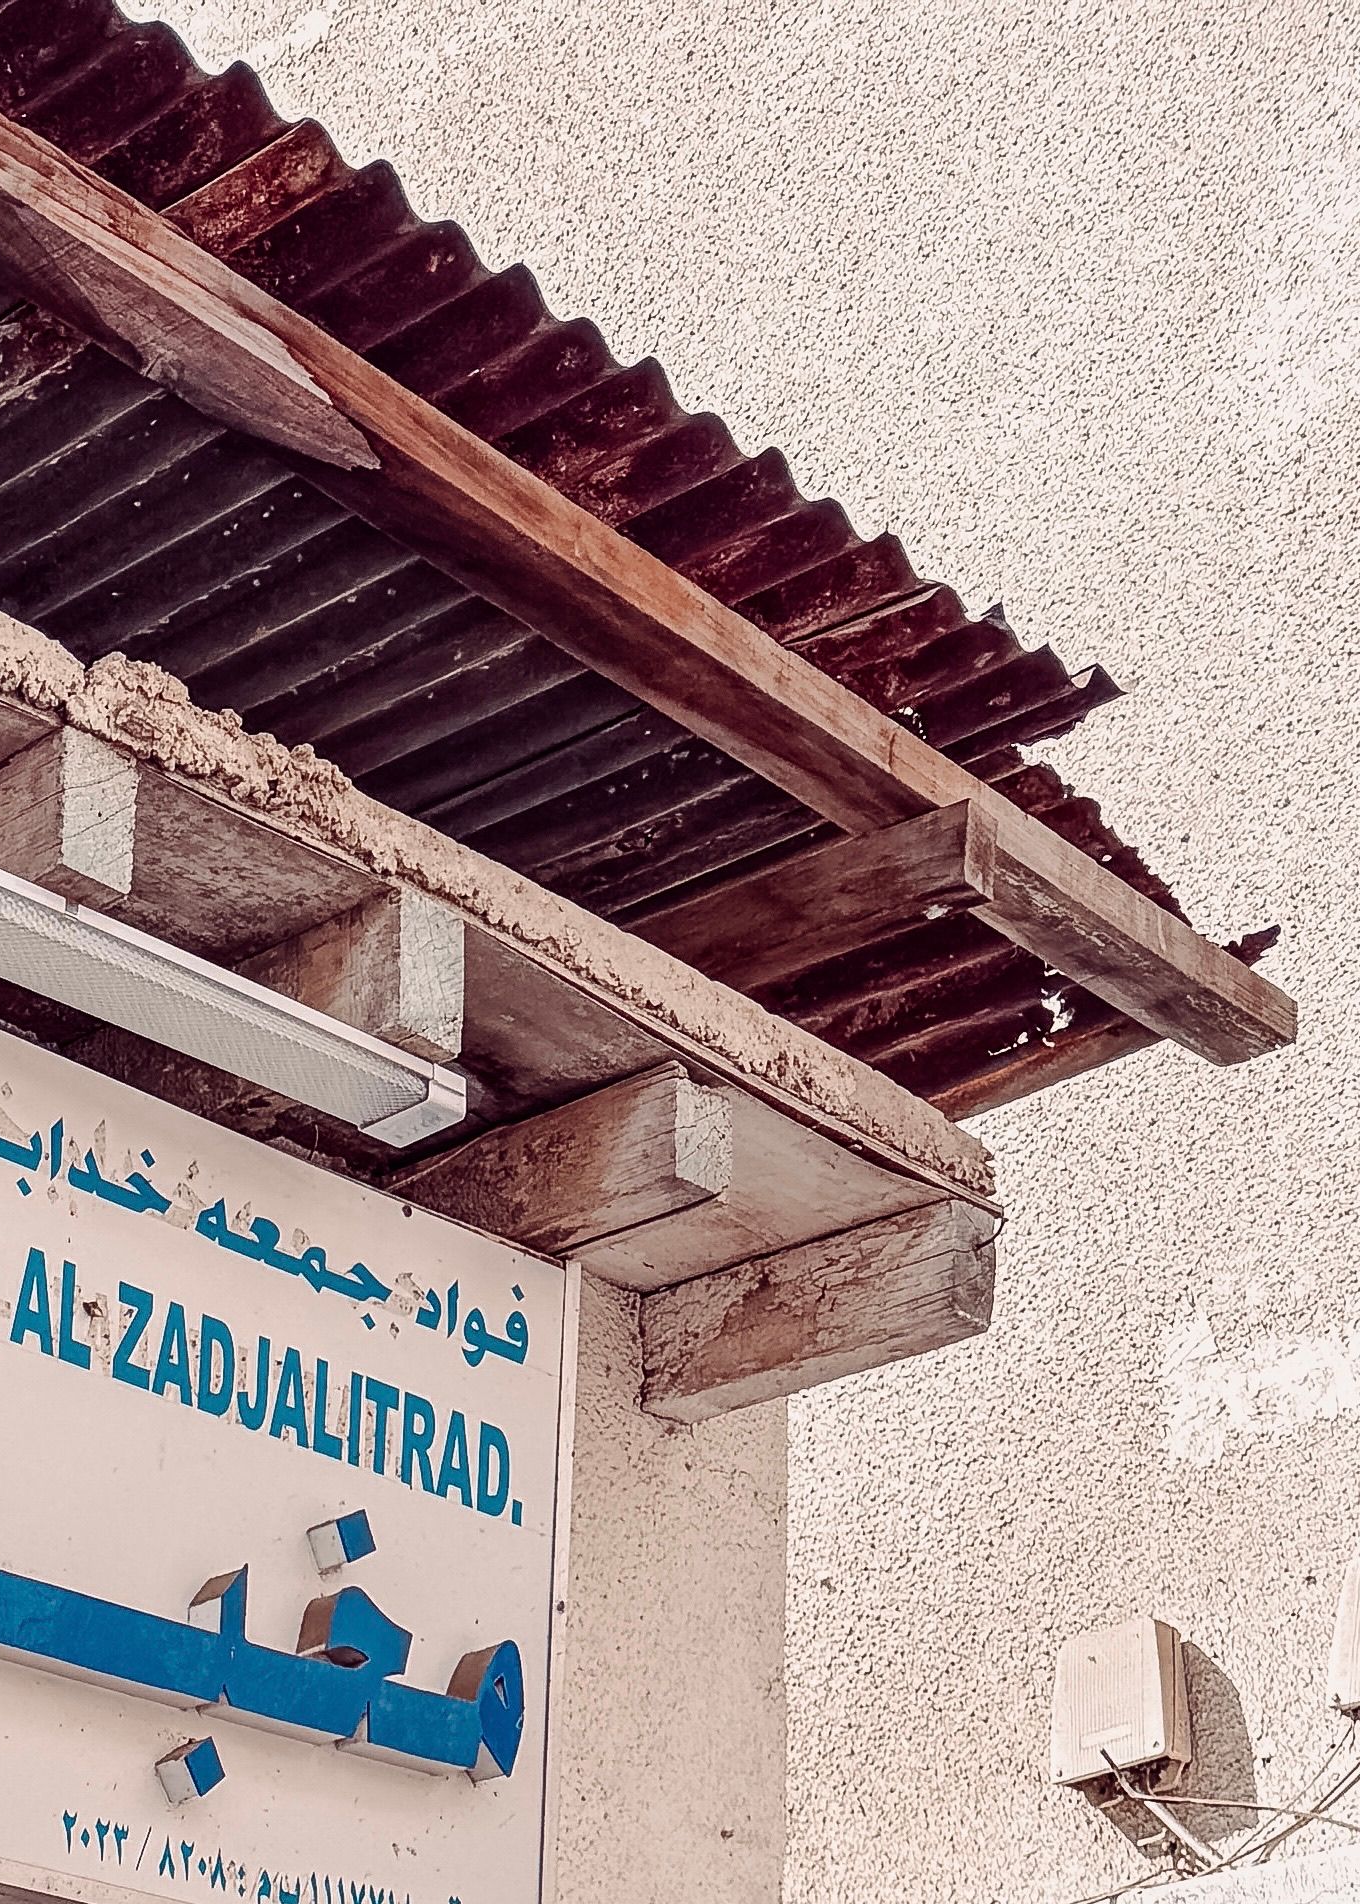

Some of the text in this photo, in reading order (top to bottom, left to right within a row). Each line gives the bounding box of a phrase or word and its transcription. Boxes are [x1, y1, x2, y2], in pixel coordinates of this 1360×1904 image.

[10, 1246, 92, 1371] AL
[195, 1199, 392, 1330] جمعه
[416, 1283, 529, 1368] فواد
[62, 1808, 130, 1866] ٢٠٢٣
